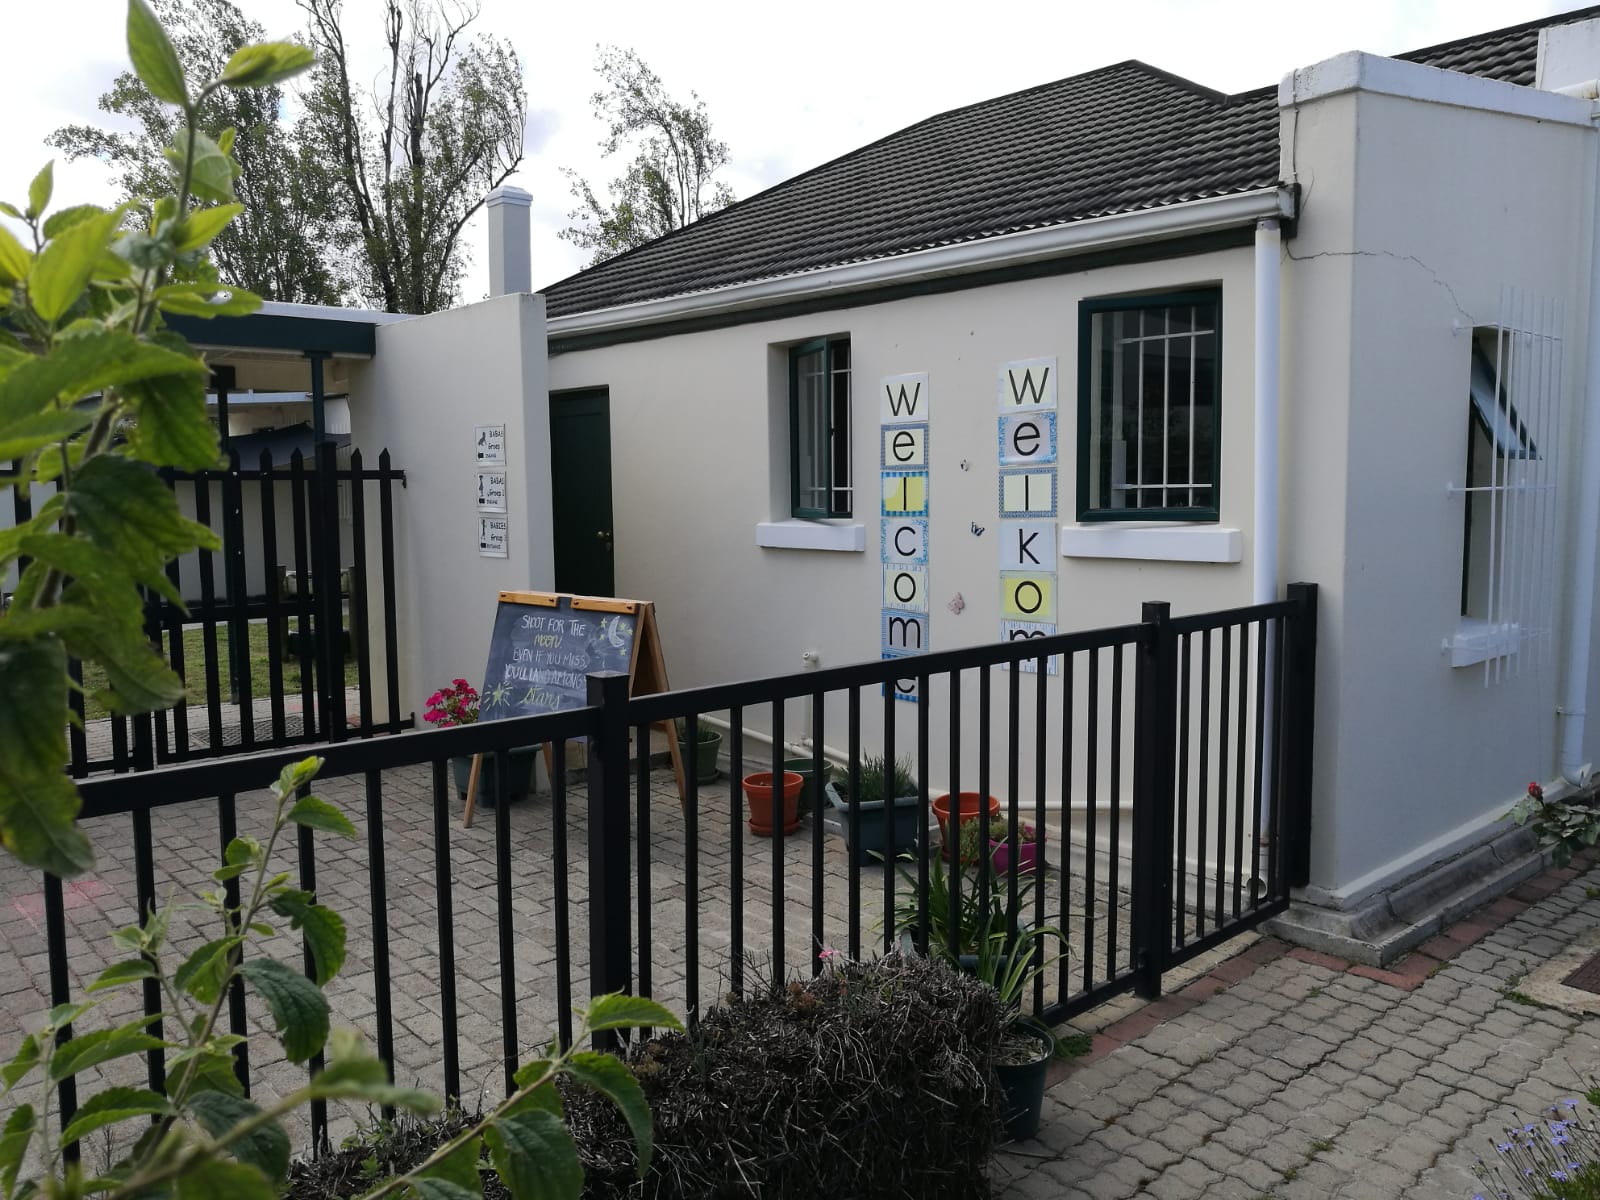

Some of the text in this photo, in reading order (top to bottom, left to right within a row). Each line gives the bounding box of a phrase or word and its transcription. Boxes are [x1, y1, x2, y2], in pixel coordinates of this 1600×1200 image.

[521, 614, 588, 637] SHOOT FOR THE
[513, 647, 533, 663] EVEN
[535, 650, 545, 663] IF
[546, 652, 561, 666] YOU
